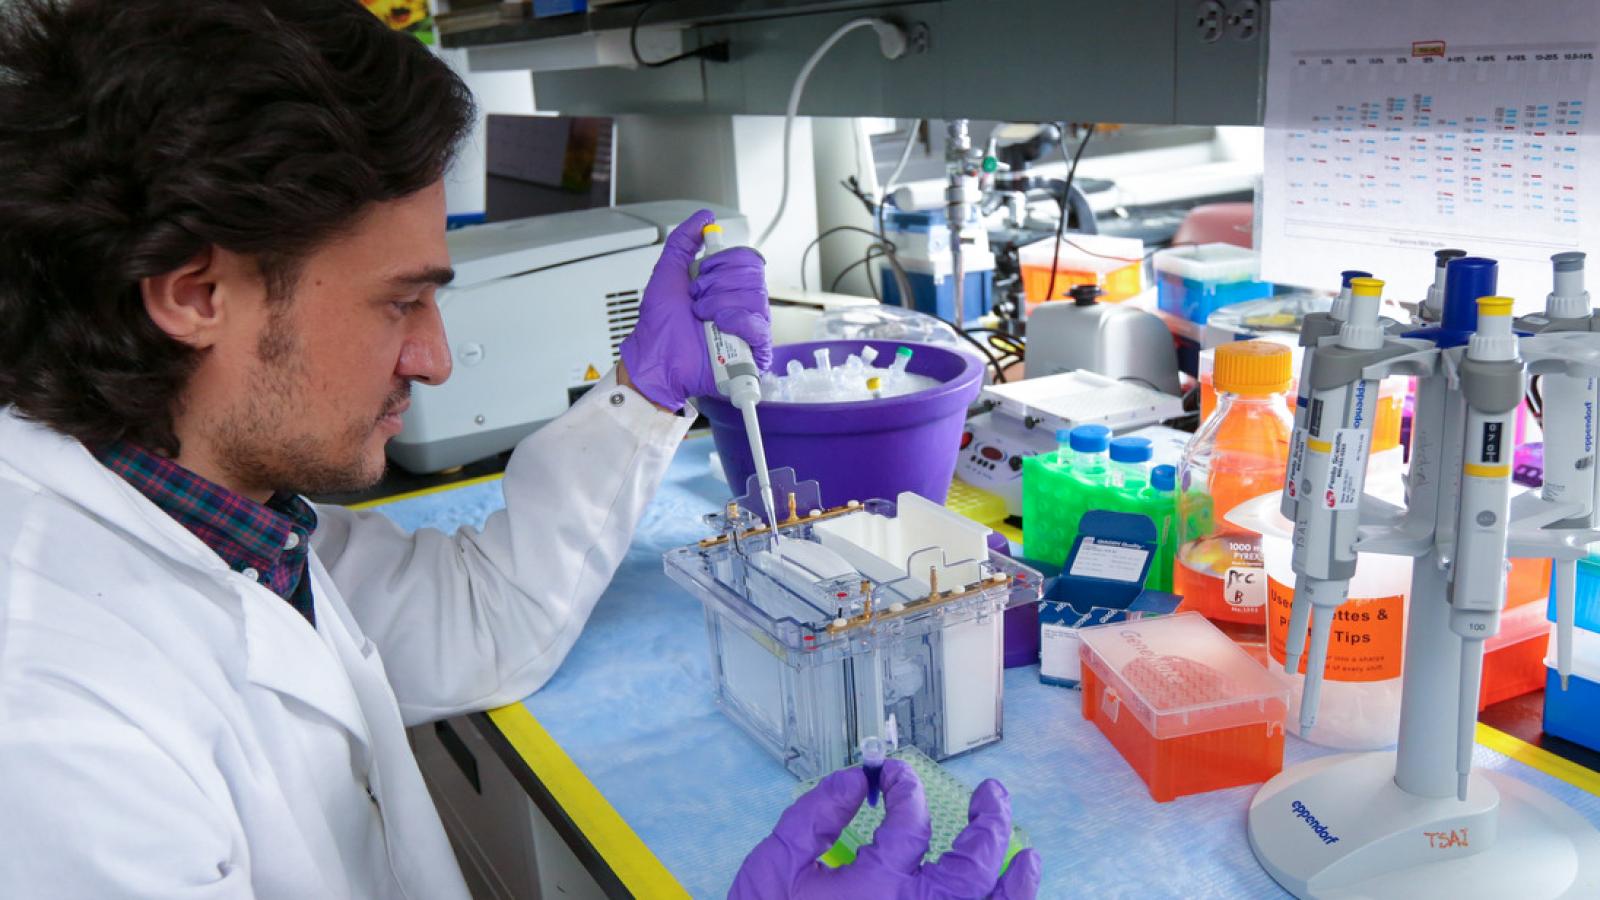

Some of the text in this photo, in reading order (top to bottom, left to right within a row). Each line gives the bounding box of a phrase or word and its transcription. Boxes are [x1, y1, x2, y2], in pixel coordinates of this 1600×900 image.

[1353, 379, 1366, 429] eppendo
[1229, 542, 1252, 551] 1000
[1377, 608, 1388, 621] &
[1468, 623, 1486, 633] 100
[1334, 631, 1371, 645] Tips
[1291, 800, 1340, 845] eppendorf
[1424, 827, 1469, 849] TSAI
